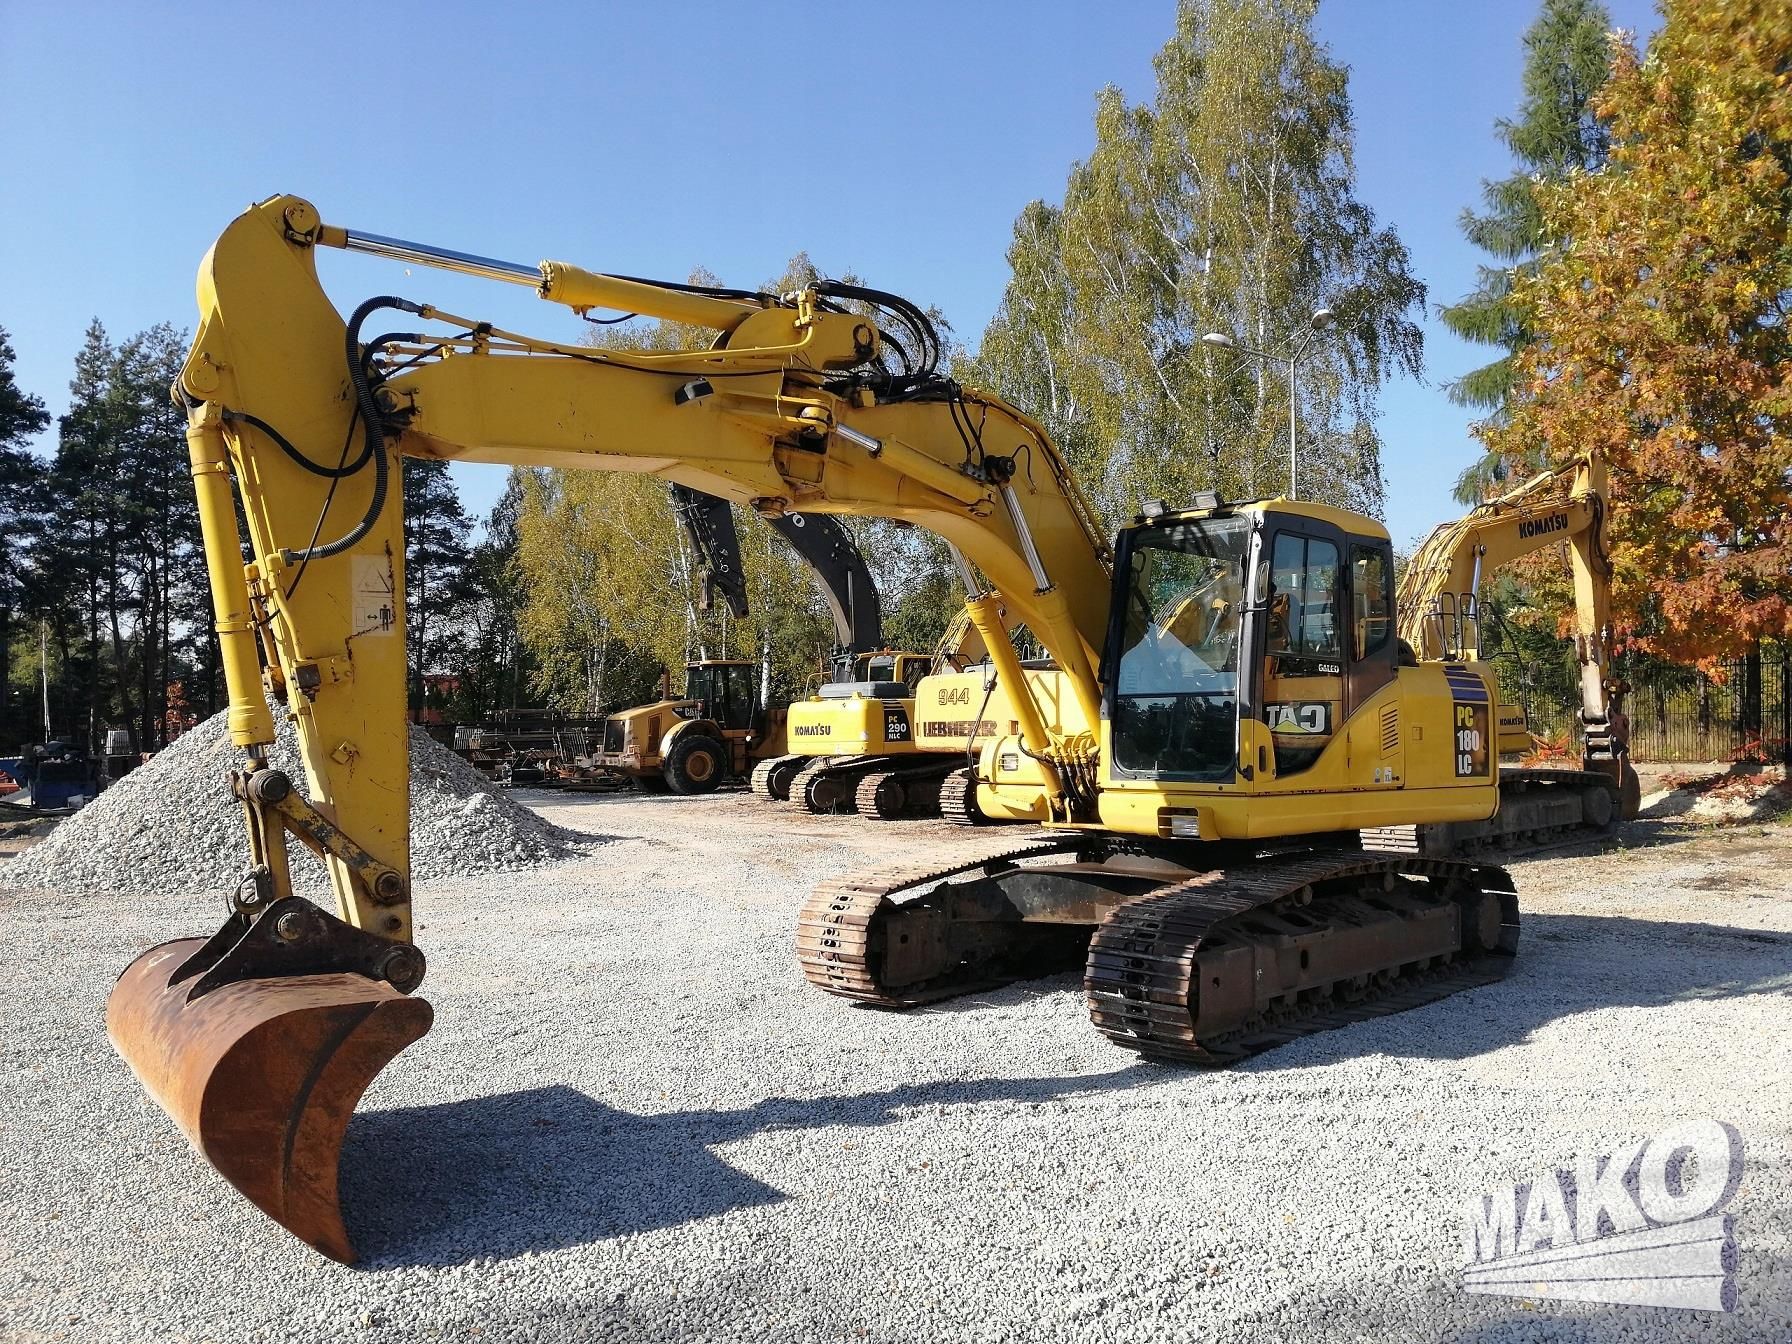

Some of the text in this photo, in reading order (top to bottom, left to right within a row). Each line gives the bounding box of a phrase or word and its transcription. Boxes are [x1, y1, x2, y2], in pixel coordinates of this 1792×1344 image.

[1519, 511, 1568, 539] KOMATSU
[938, 688, 969, 705] 944
[888, 715, 898, 723] PC
[1456, 706, 1474, 727] PC
[1499, 716, 1524, 726] KOMATSU
[794, 723, 831, 736] KOMATSU
[888, 723, 907, 733] 290
[1457, 730, 1480, 751] 180
[1458, 754, 1472, 774] LC
